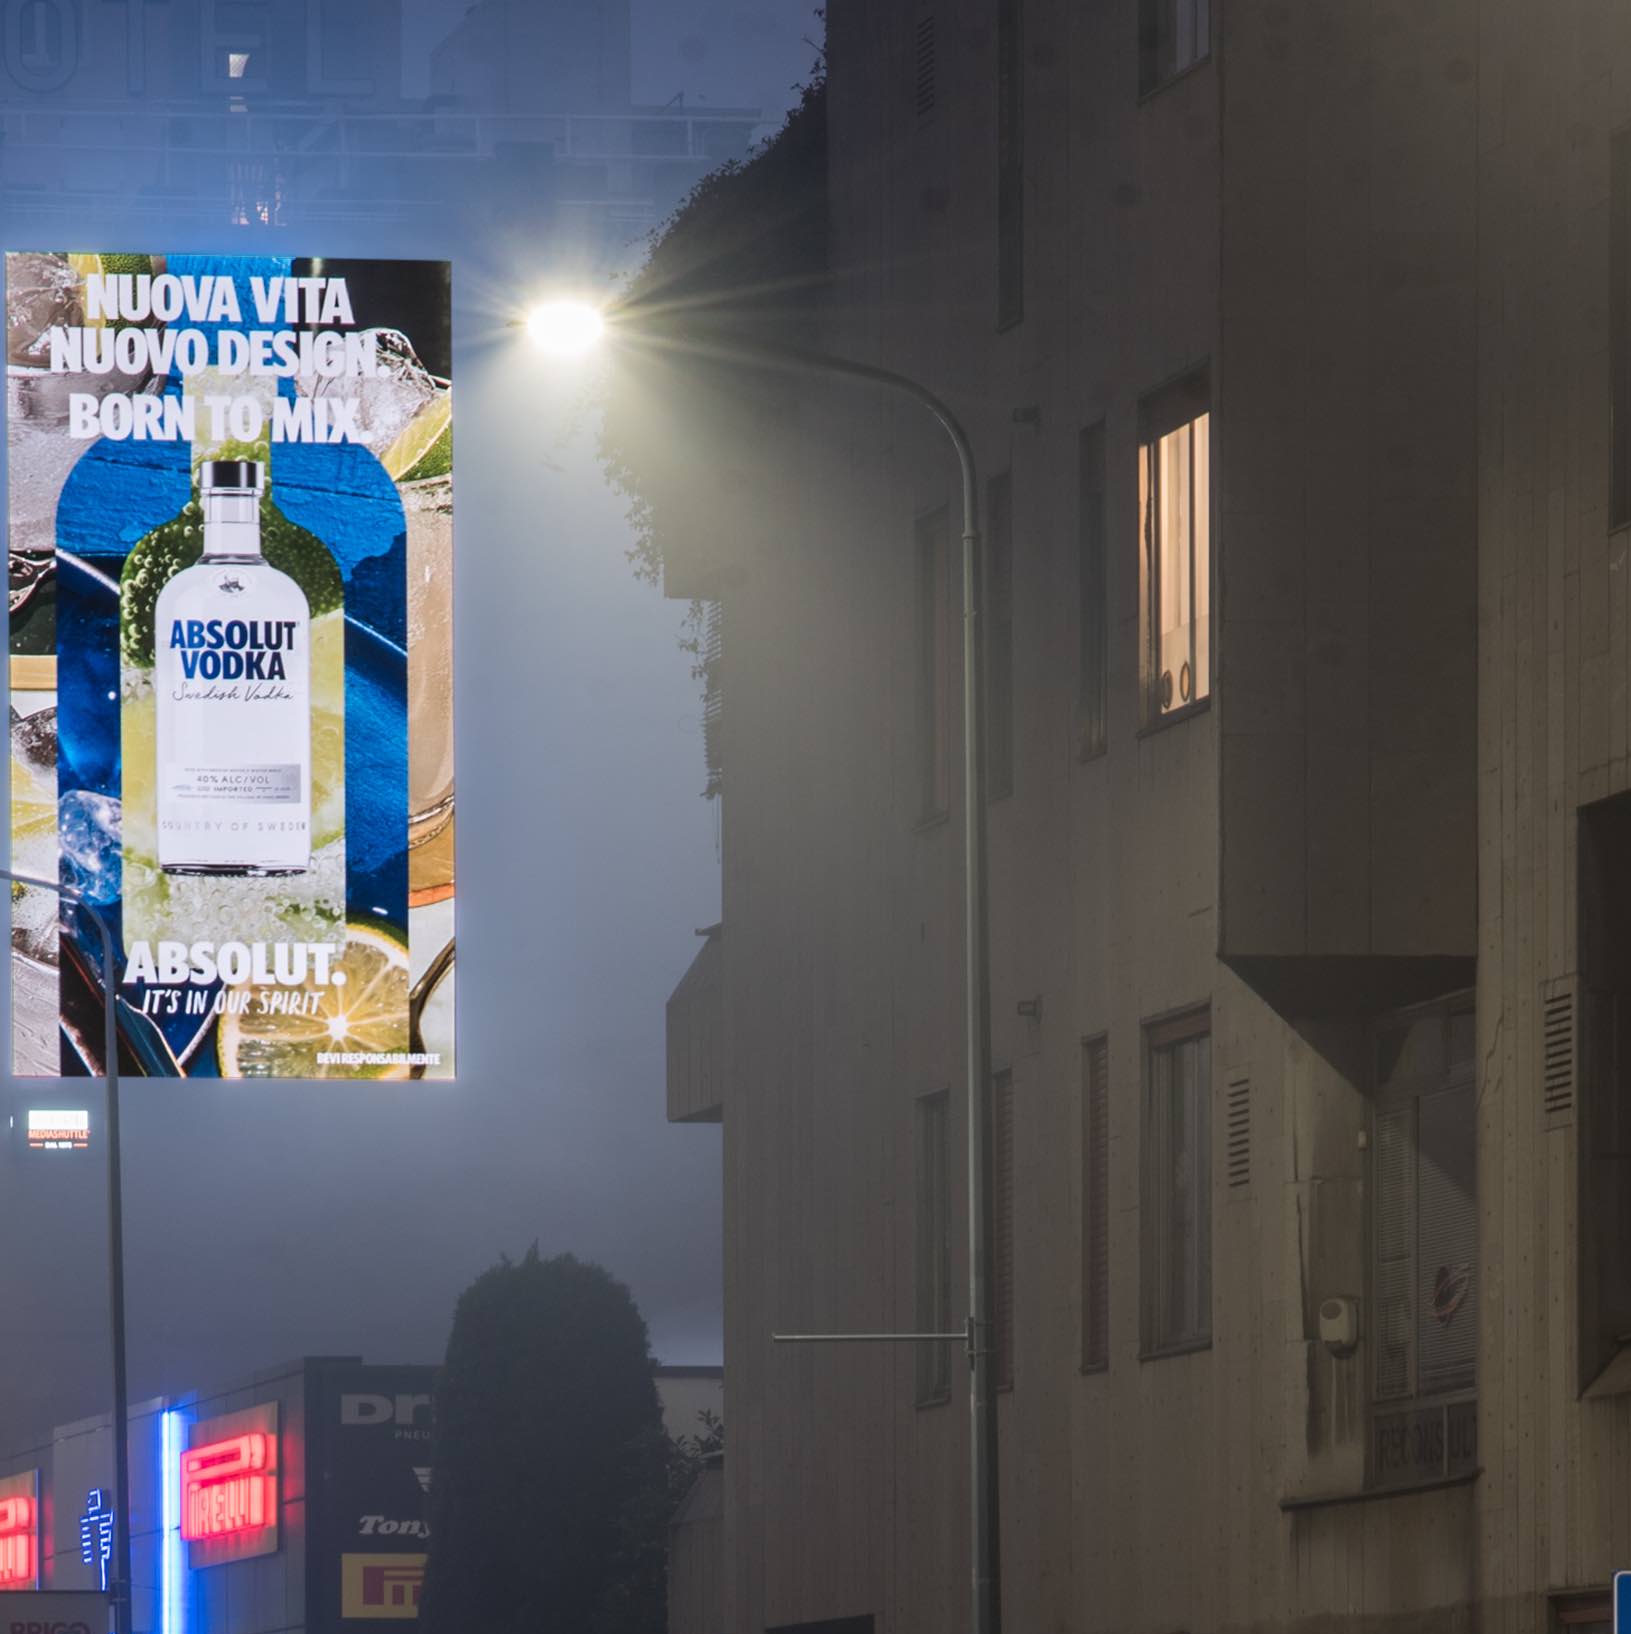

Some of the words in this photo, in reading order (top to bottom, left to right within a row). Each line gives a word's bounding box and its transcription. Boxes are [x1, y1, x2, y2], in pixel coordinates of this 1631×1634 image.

[86, 273, 242, 322] NUOVA
[250, 276, 355, 325] VITA
[50, 327, 208, 376] NUOVO
[218, 329, 392, 379] DESIGN.
[69, 392, 195, 441] BORN
[205, 394, 264, 442] TO
[272, 396, 375, 444] MIX.
[170, 619, 297, 650] ABSOLUT
[180, 650, 286, 680] VODKA
[172, 681, 240, 701] Swedish
[244, 683, 294, 702] Vodka
[231, 822, 248, 832] OF
[121, 940, 348, 986] ABSOLUT.
[141, 989, 182, 1014] IT'S
[185, 990, 207, 1014] IN
[214, 990, 251, 1014] OUR
[257, 990, 326, 1015] SPIRIT
[316, 1053, 342, 1065] BEVI
[180, 1433, 278, 1542] PIRELLI
